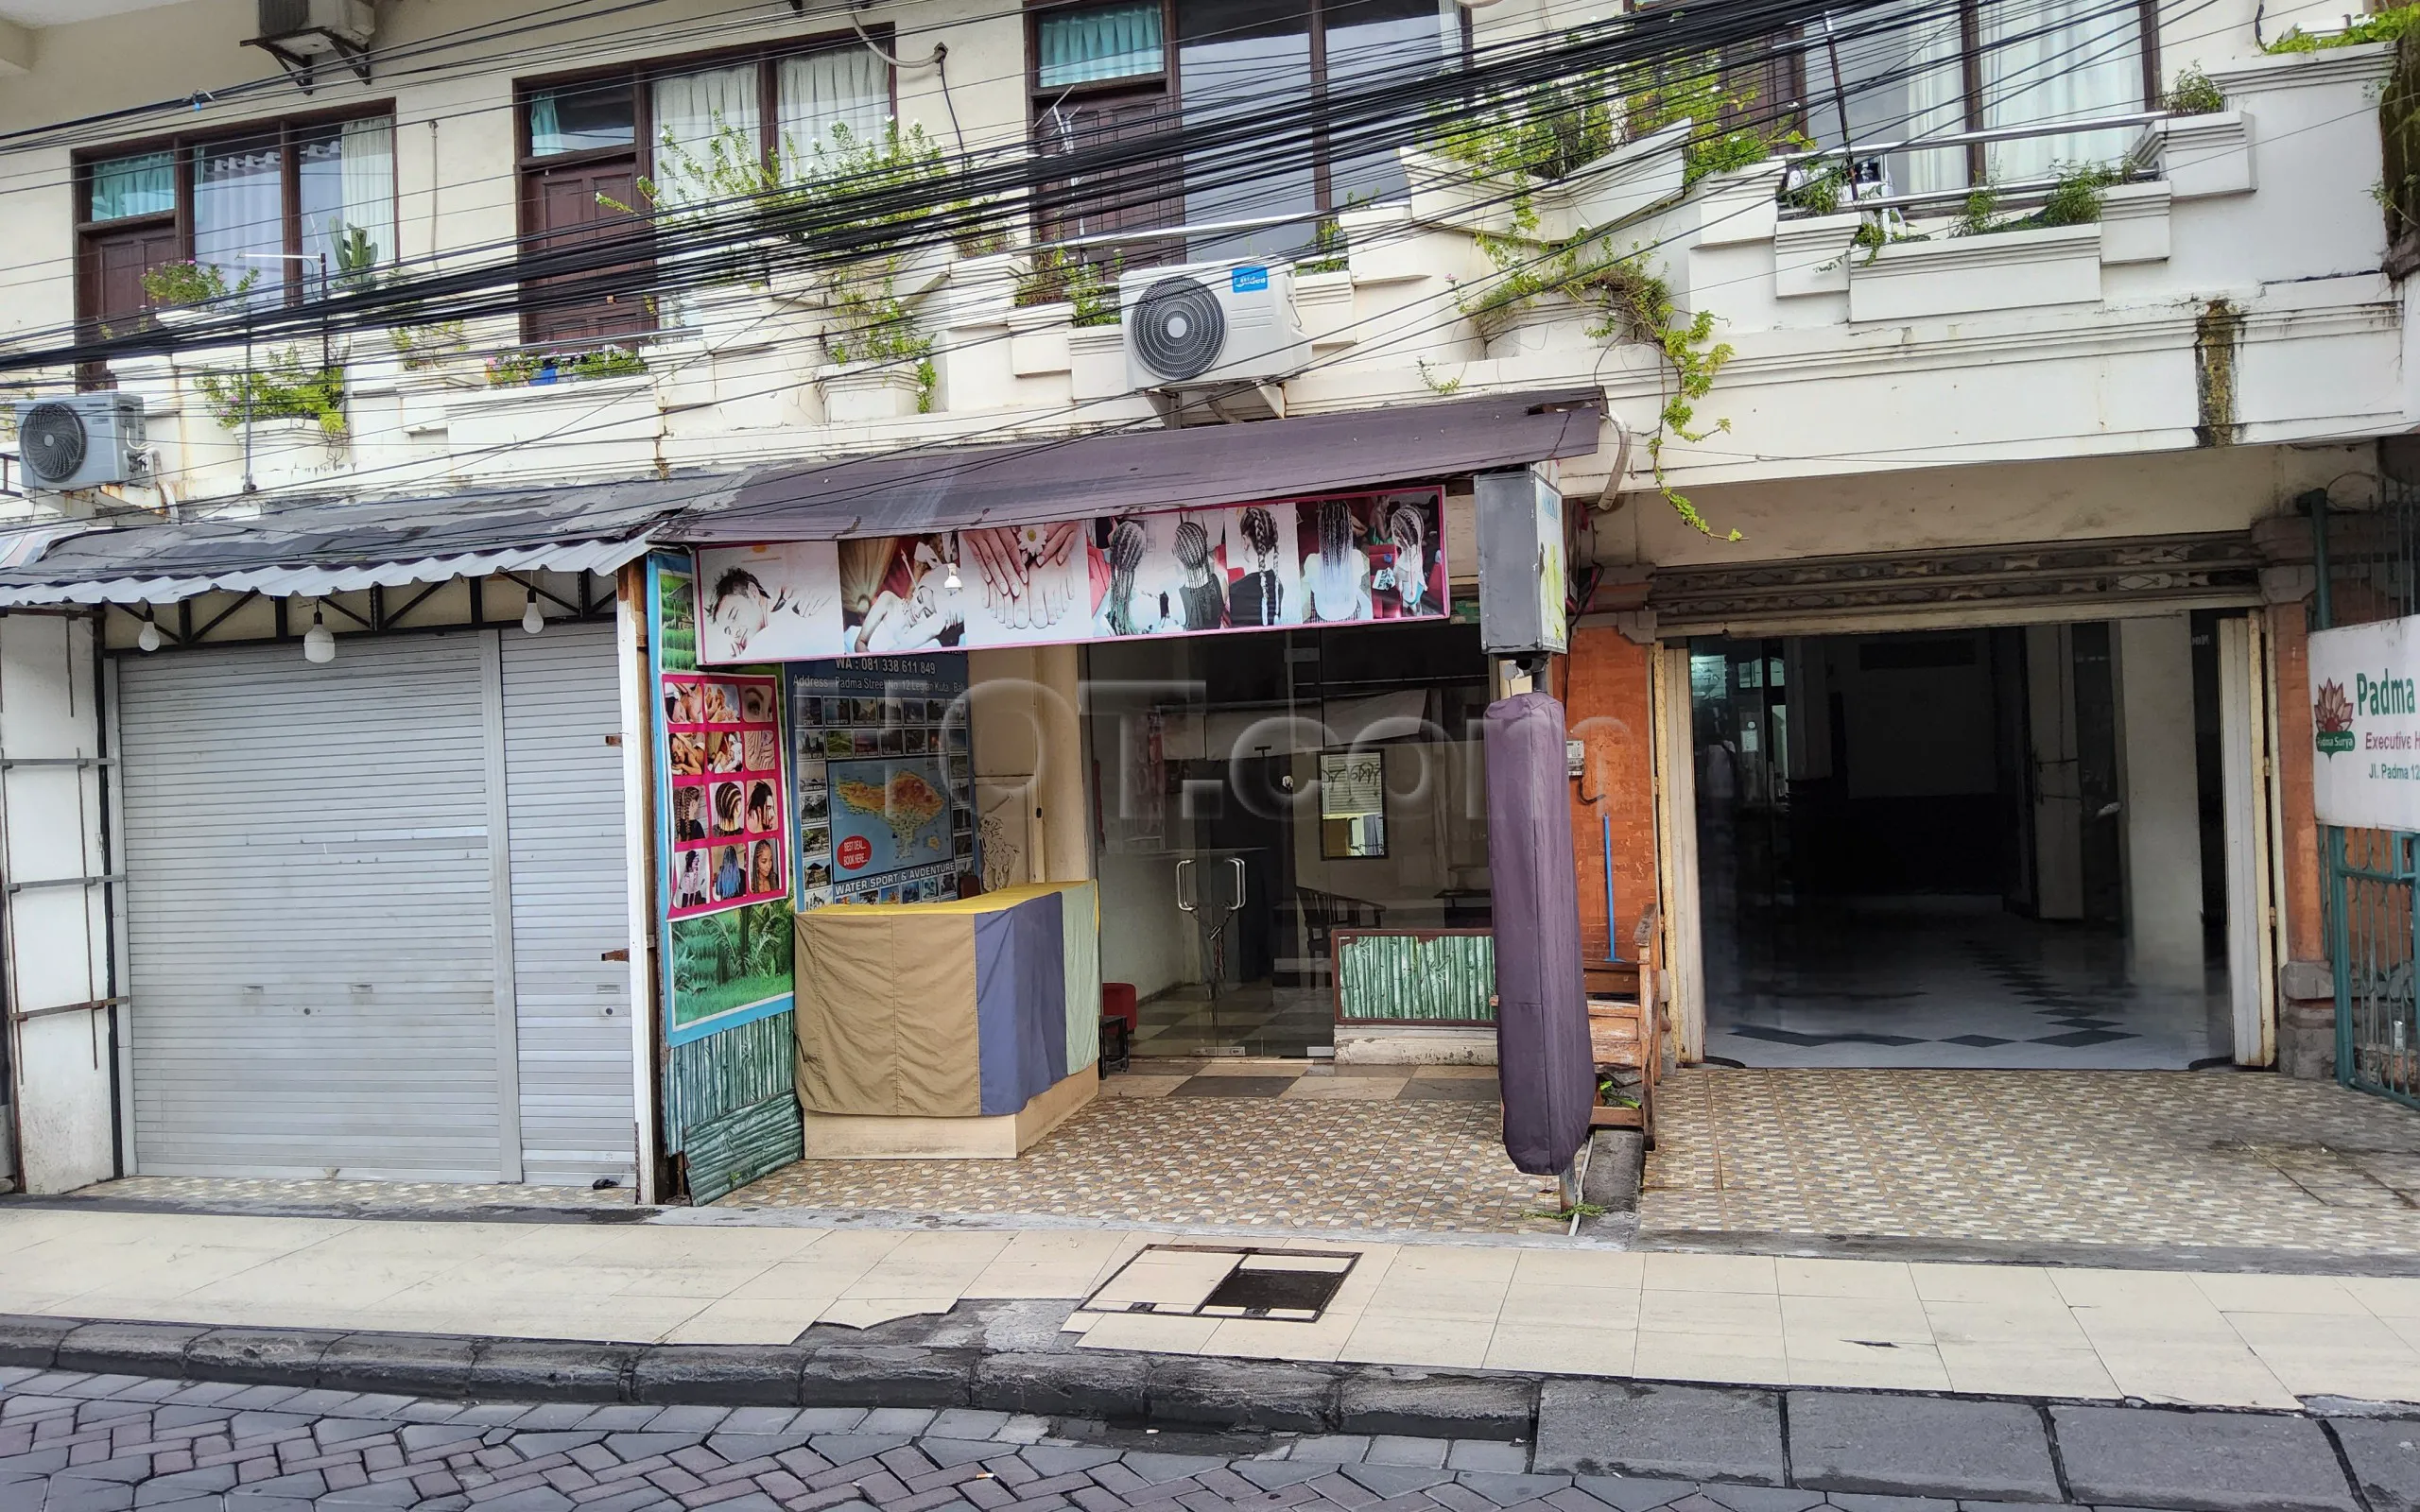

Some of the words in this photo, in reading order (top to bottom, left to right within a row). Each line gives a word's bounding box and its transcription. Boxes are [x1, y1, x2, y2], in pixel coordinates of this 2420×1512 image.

[836, 658, 853, 670] WA
[861, 658, 879, 671] 081
[883, 659, 899, 672] 338
[902, 661, 918, 673] 611
[920, 662, 936, 675] 849
[793, 674, 828, 688] Address
[835, 676, 862, 689] Padma
[902, 680, 910, 691] 12
[2357, 668, 2415, 716] Padma
[2334, 736, 2354, 749] Surya
[2365, 731, 2411, 751] Executive
[2380, 763, 2409, 781] Padma
[843, 840, 854, 852] BEST
[843, 854, 855, 866] BOOK
[835, 880, 868, 896] WATER
[870, 873, 899, 888] SPORT
[901, 871, 908, 881] &
[909, 862, 956, 880] AVDENTURE
